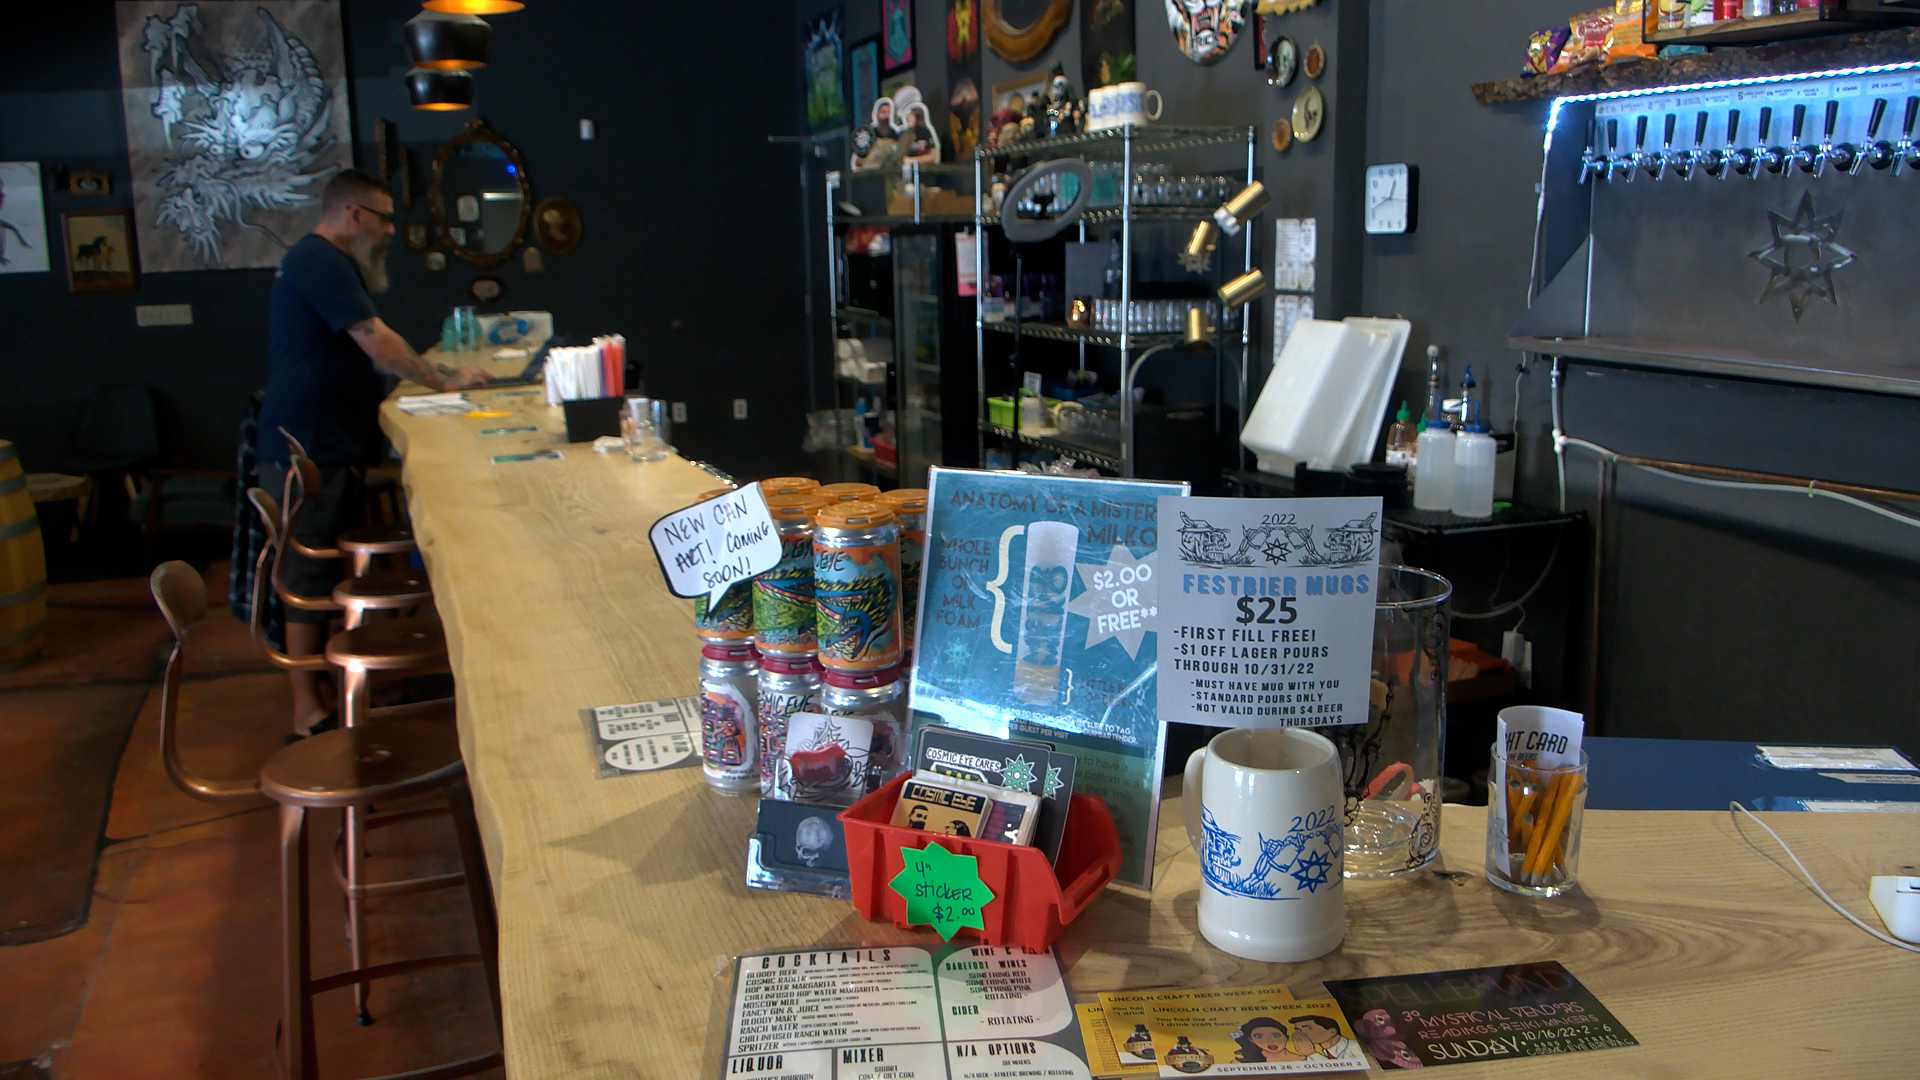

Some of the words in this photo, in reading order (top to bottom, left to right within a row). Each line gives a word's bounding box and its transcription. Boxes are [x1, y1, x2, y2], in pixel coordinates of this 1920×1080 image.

[952, 490, 1038, 513] ANATOMY
[1043, 497, 1069, 514] OF
[1070, 501, 1086, 515] A
[1091, 501, 1157, 521] MISTER
[1261, 513, 1297, 525] 2022
[664, 512, 705, 545] NEW
[675, 539, 717, 573] ART!
[726, 521, 769, 553] COMING
[941, 539, 991, 557] WHOLE
[703, 556, 752, 588] SOON!
[937, 555, 989, 574] BUNCH
[1093, 563, 1152, 591] $2.00
[1183, 574, 1297, 596] FESTBIER
[1305, 574, 1370, 596] MUGS
[943, 594, 975, 610] MILK
[1111, 588, 1139, 609] OR
[1235, 594, 1298, 626] $25
[936, 610, 980, 629] FOAM
[1232, 629, 1265, 643] FILL
[1271, 629, 1316, 643] FREE!
[1201, 644, 1226, 658] OFF
[1231, 646, 1278, 659] LAGER
[1283, 646, 1329, 659] POURS
[1174, 659, 1239, 675] THROUGH
[1244, 663, 1315, 676] 10/31/22
[1228, 681, 1258, 692] HAVE
[1261, 682, 1284, 692] MUG
[1288, 681, 1315, 691] WITH
[1319, 679, 1340, 689] YOU
[1257, 693, 1293, 704] POURS
[1296, 693, 1324, 703] ONLY
[1221, 705, 1253, 715] VALID
[1257, 706, 1296, 716] DURING
[1300, 704, 1313, 715] $4
[1317, 703, 1343, 714] BEER
[1105, 724, 1115, 732] TO
[1115, 726, 1131, 734] TAG
[1279, 715, 1343, 728] THURSDAYS
[1020, 724, 1040, 734] GUEST
[1041, 728, 1052, 737] PER
[1054, 731, 1069, 740] VISIT
[1526, 731, 1568, 754] CARD
[926, 747, 957, 763] COSMIC
[959, 755, 974, 767] EYE
[975, 758, 1001, 772] CARES
[911, 785, 952, 806] COSMIC
[1289, 805, 1335, 833] 2022
[932, 902, 975, 924] $2.00
[762, 949, 891, 969] COCKTAILS
[971, 946, 995, 957] WINE
[945, 960, 989, 971] BAREFOOT
[998, 959, 1027, 969] WINES
[747, 970, 776, 979] BLOODY
[778, 968, 798, 976] BEER
[969, 971, 1010, 979] SOMETHING
[745, 985, 763, 994] HOP
[764, 983, 789, 992] WATER
[791, 981, 836, 990] MARGARITA
[746, 977, 776, 986] COSMIC
[966, 978, 1008, 986] SOMETHING
[970, 985, 1012, 993] SOMETHING
[744, 993, 764, 1002] CHILI
[764, 991, 795, 1000] INFUSED
[799, 990, 812, 998] HOP
[813, 987, 838, 996] WATER
[839, 984, 880, 994] MARGARITA
[1193, 991, 1221, 999] BEER
[1224, 989, 1254, 997] WEEK
[742, 1009, 767, 1019] FANCY
[770, 1007, 785, 1016] GIN
[786, 1006, 794, 1015] &
[797, 1004, 820, 1014] JUICE
[743, 1000, 778, 1010] MOSCOW
[780, 998, 800, 1007] MULE
[951, 1005, 979, 1016] CIDER
[1272, 1003, 1304, 1011] WEEK
[741, 1017, 773, 1027] BLOODY
[774, 1014, 798, 1024] MARY
[987, 1015, 1034, 1026] ROTATING
[1419, 1009, 1510, 1028] MYSTICAL
[1508, 1001, 1585, 1018] VENDORS
[740, 1025, 768, 1035] RANCH
[771, 1022, 799, 1032] WATER
[1602, 1023, 1612, 1032] 6
[739, 1034, 760, 1044] CHILI
[761, 1032, 794, 1042] INFUSED
[794, 1029, 821, 1039] RANCH
[822, 1027, 848, 1037] WATER
[738, 1041, 780, 1053] SPRITZER
[956, 1044, 977, 1057] N/A
[988, 1042, 1037, 1056] OPTIONS
[843, 1047, 884, 1064] MIXER
[732, 1055, 783, 1074] LIQUOR
[874, 1064, 899, 1073] SQUIRT
[1303, 1061, 1353, 1069] OCTOBER
[898, 1071, 917, 1079] COKE
